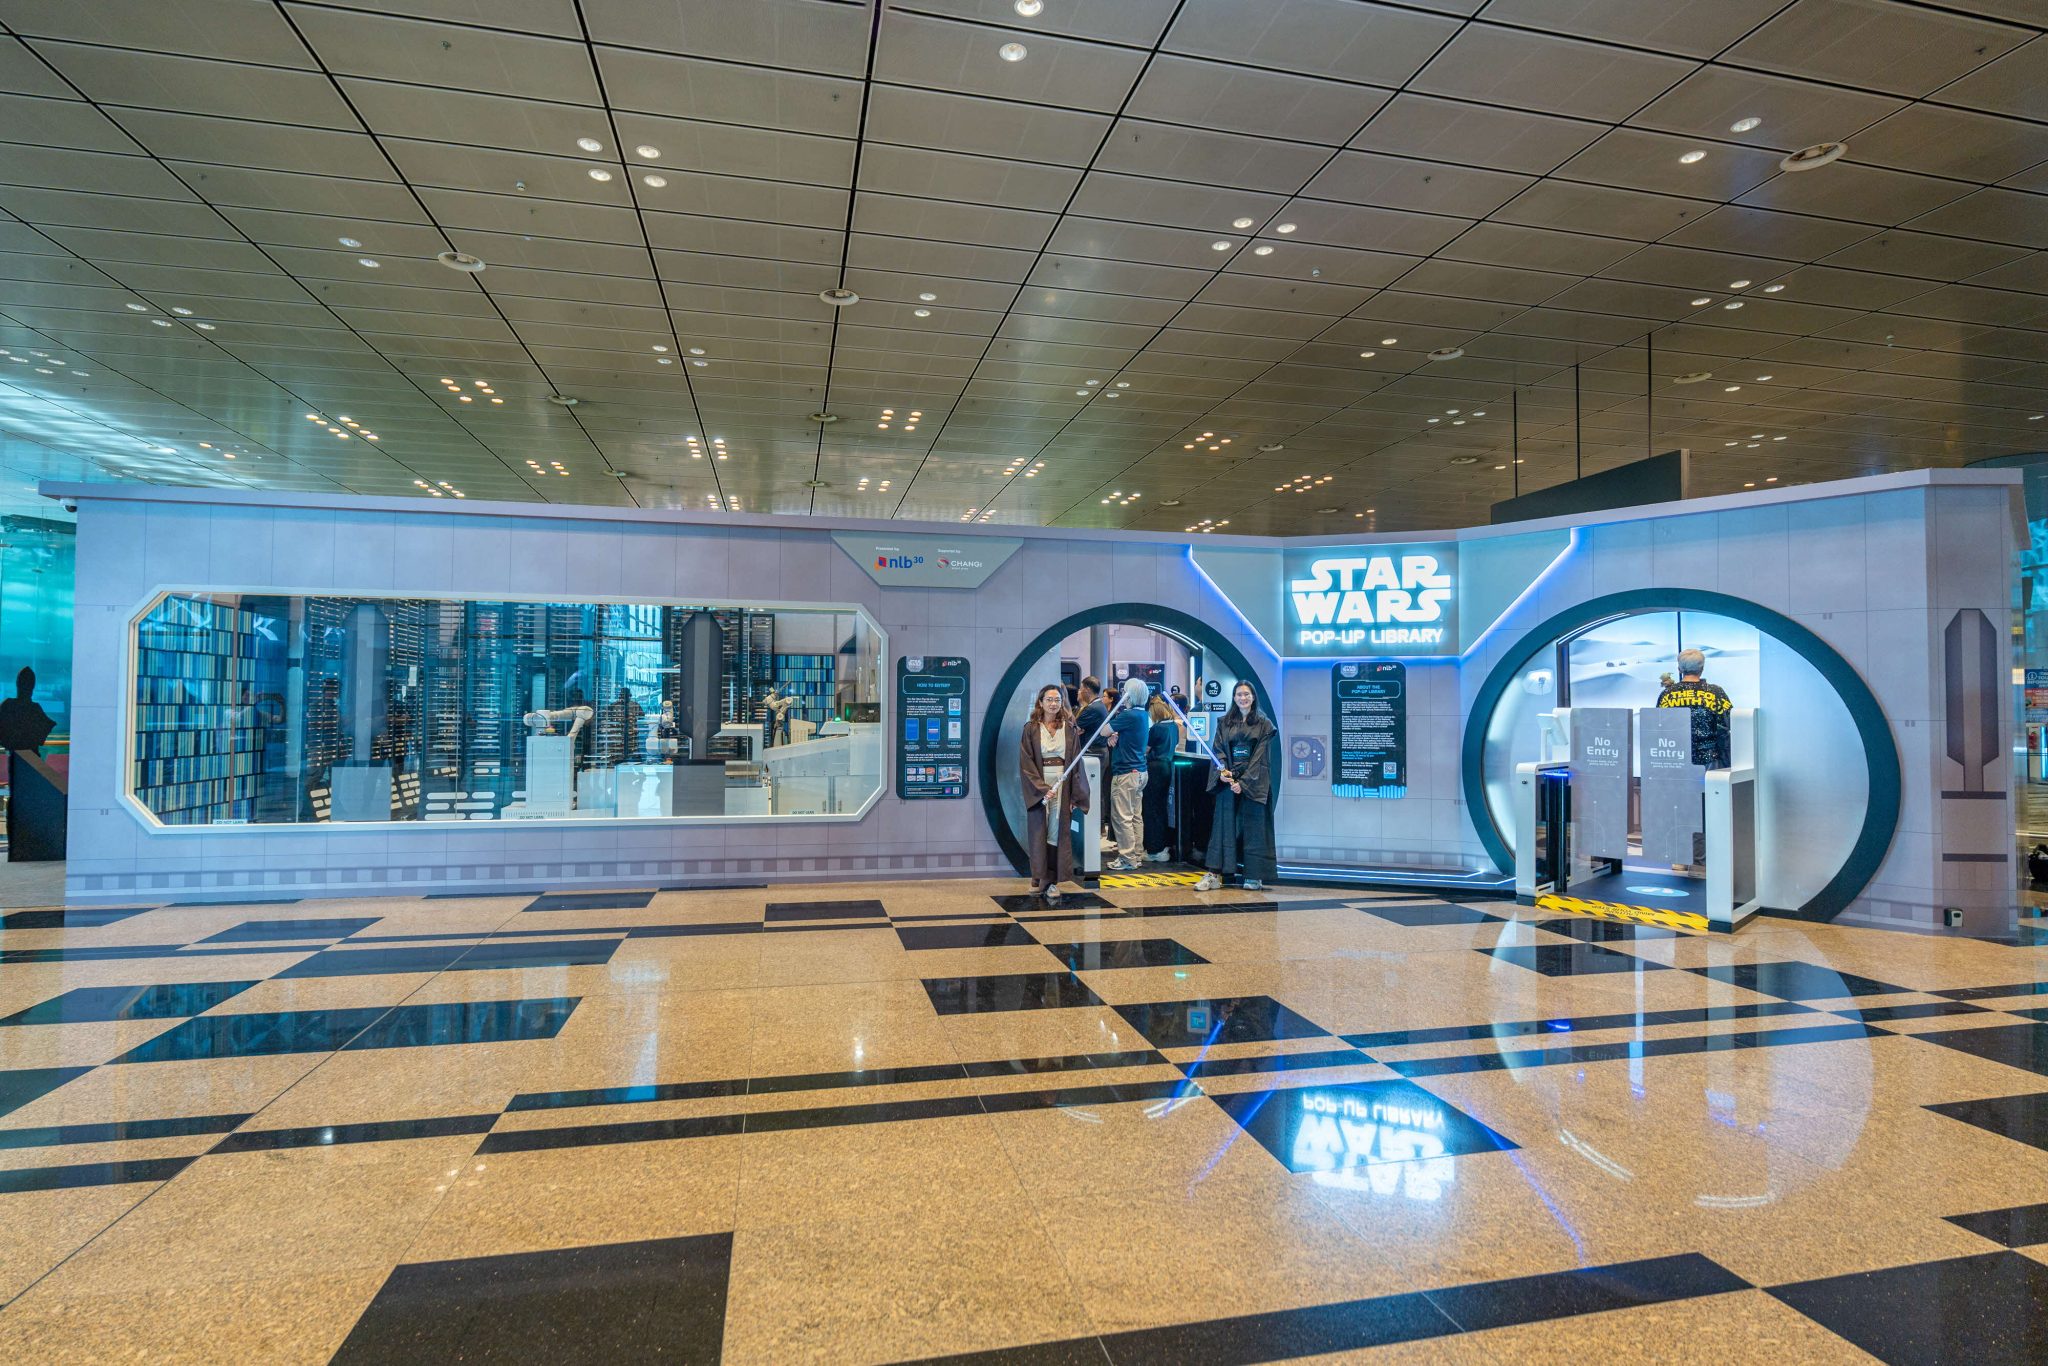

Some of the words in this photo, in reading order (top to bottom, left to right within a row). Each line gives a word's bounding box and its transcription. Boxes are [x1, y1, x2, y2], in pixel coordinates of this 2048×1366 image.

[1292, 556, 1450, 592] STAR
[1292, 589, 1451, 624] WARS
[1301, 630, 1366, 644] POP-UP
[1371, 628, 1443, 643] LIBRARY
[1671, 690, 1694, 698] THE
[1668, 697, 1702, 707] WITH
[1594, 737, 1610, 746] No
[1658, 738, 1676, 748] No
[1587, 746, 1618, 758] Entry
[1650, 748, 1684, 759] Entry
